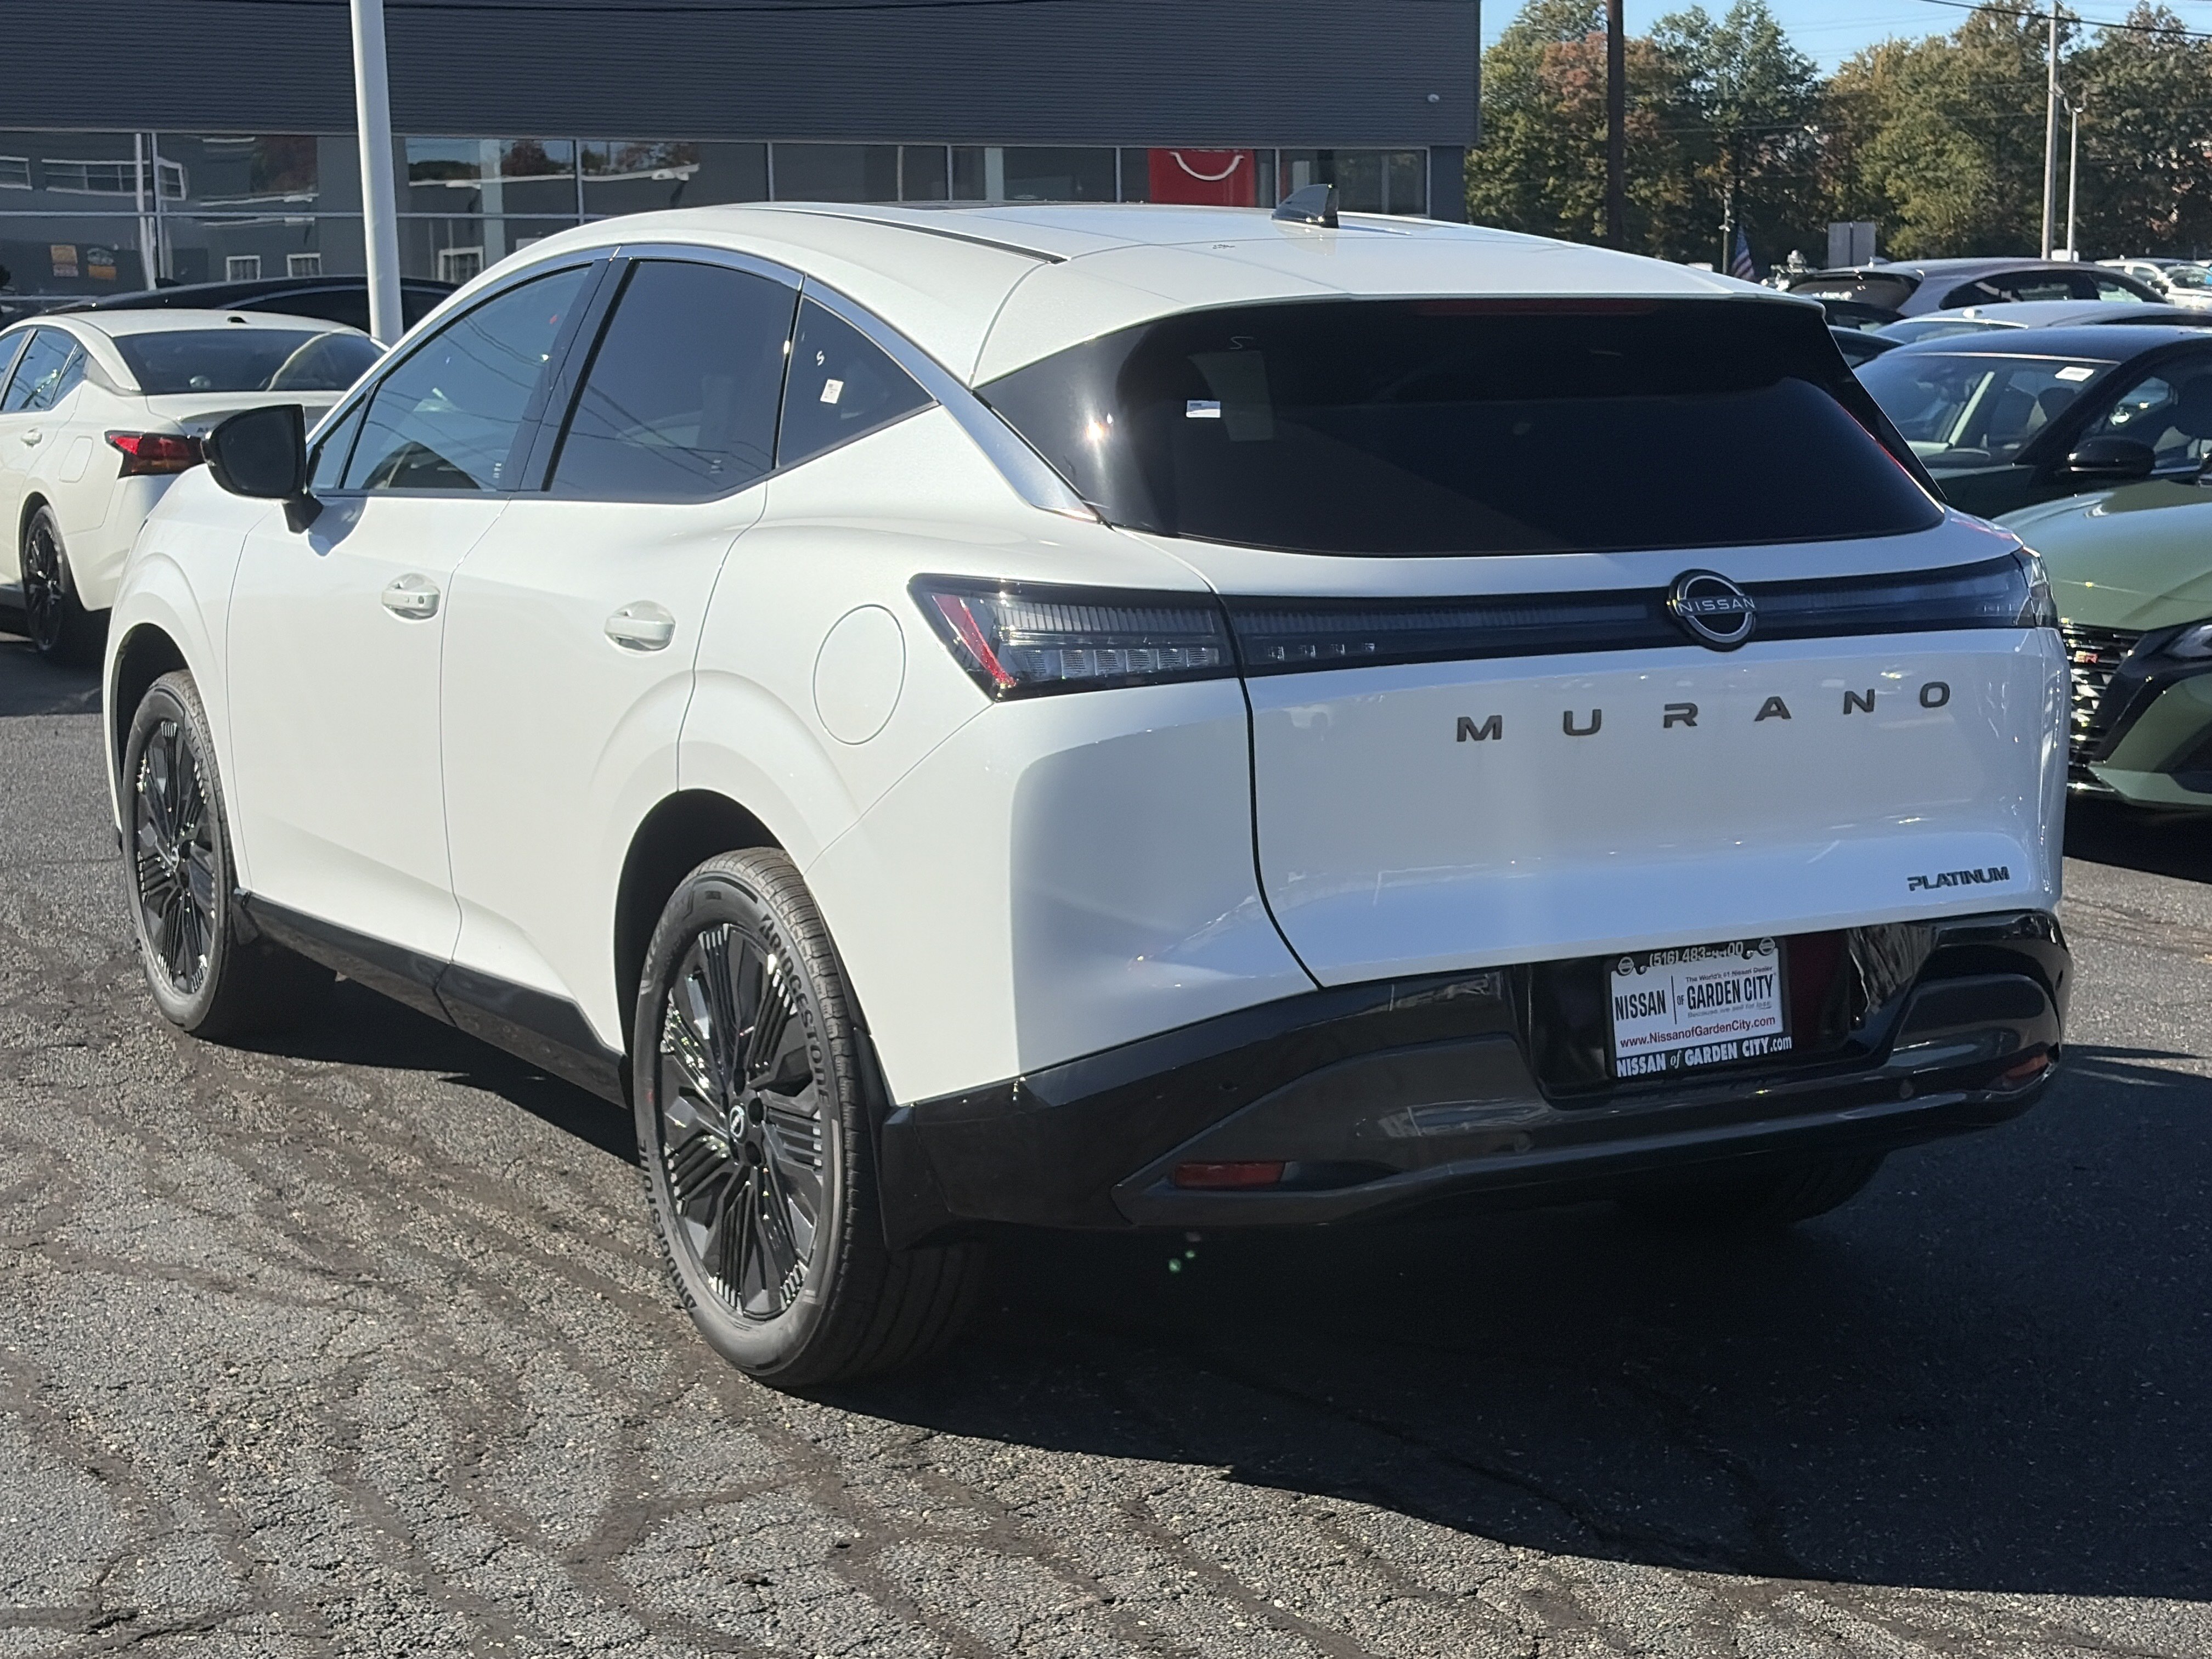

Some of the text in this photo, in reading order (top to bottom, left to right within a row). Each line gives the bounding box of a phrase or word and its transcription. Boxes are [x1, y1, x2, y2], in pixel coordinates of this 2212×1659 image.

[1678, 598, 1755, 612] NISSAN
[1456, 681, 1950, 742] MURANO
[1908, 866, 2010, 891] PLATINUM
[1649, 951, 1679, 967] (516)
[759, 912, 831, 1106] BRIDGESTONE
[1615, 974, 1773, 1021] NISSAN OF GARDEN CITY
[1621, 1017, 1775, 1048] www.NissanofGardenCity.com
[1616, 1053, 1666, 1077] NISSAN
[1671, 1050, 1682, 1069] of
[1685, 1042, 1737, 1066] GARDEN
